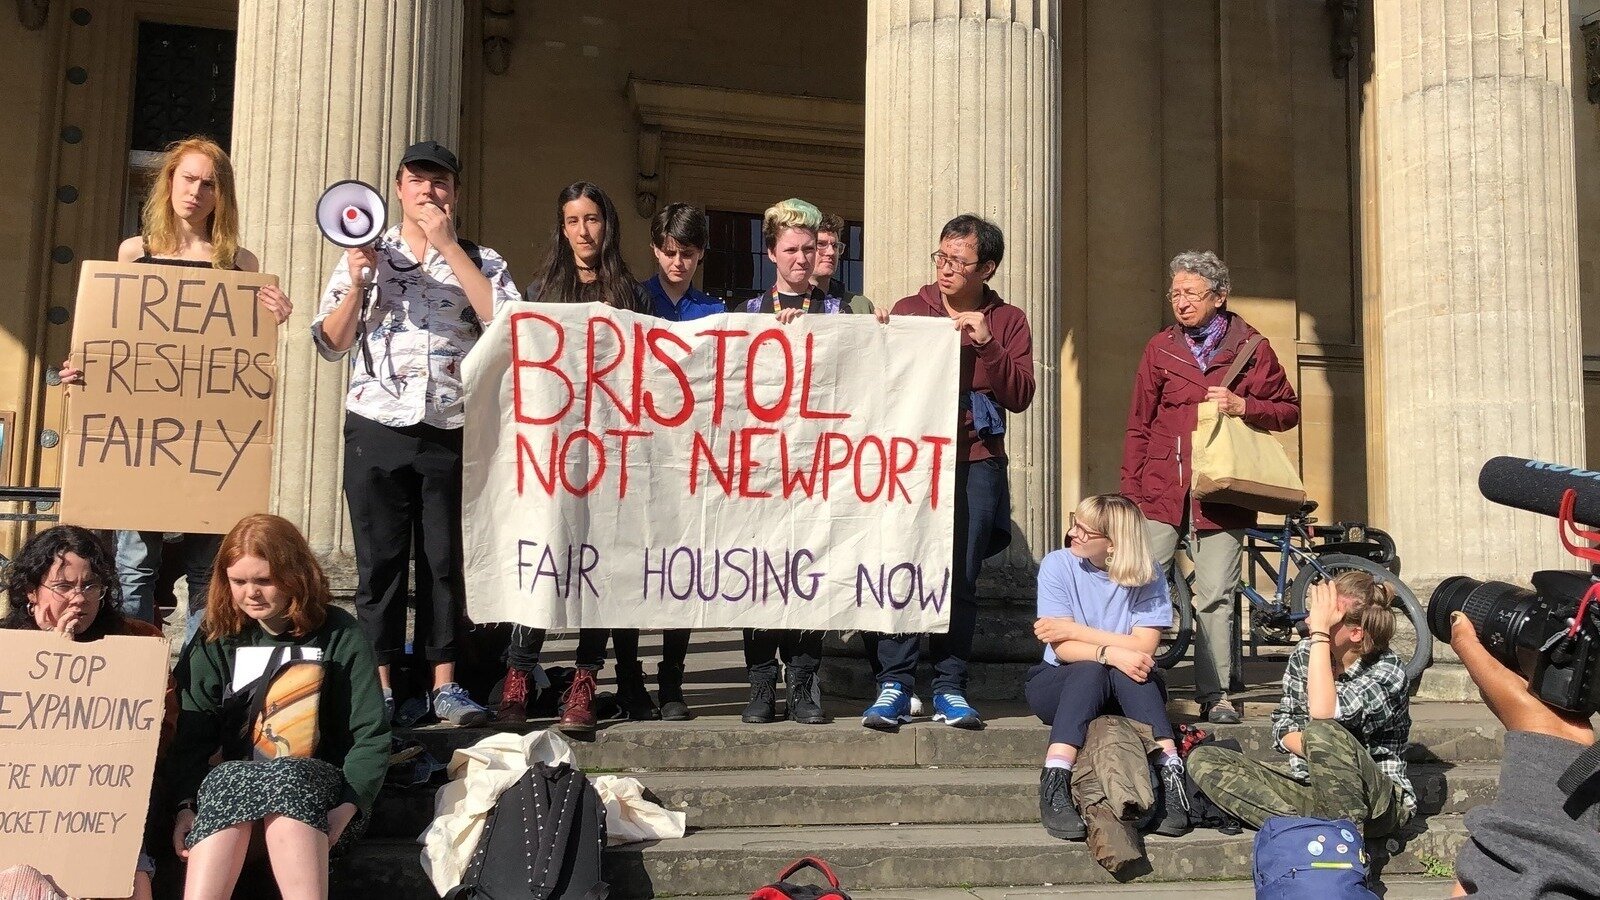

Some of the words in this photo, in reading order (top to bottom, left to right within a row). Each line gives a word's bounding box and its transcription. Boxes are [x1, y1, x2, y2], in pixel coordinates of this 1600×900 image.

[95, 273, 263, 337] TREAT
[82, 340, 273, 399] FRESHERS
[511, 312, 851, 427] BRISTOL
[78, 414, 262, 491] FAIRLY
[517, 429, 653, 498] NOT
[690, 428, 952, 510] NEWPORT
[517, 539, 600, 597] FAIR
[644, 546, 825, 601] HOUSING
[856, 562, 949, 613] NOW
[29, 651, 106, 686] STOP
[0, 691, 154, 730] EXPANDING
[0, 762, 36, 790] 'RE
[40, 763, 81, 787] NOT
[88, 763, 134, 788] YOUR
[54, 811, 127, 834] MONEY
